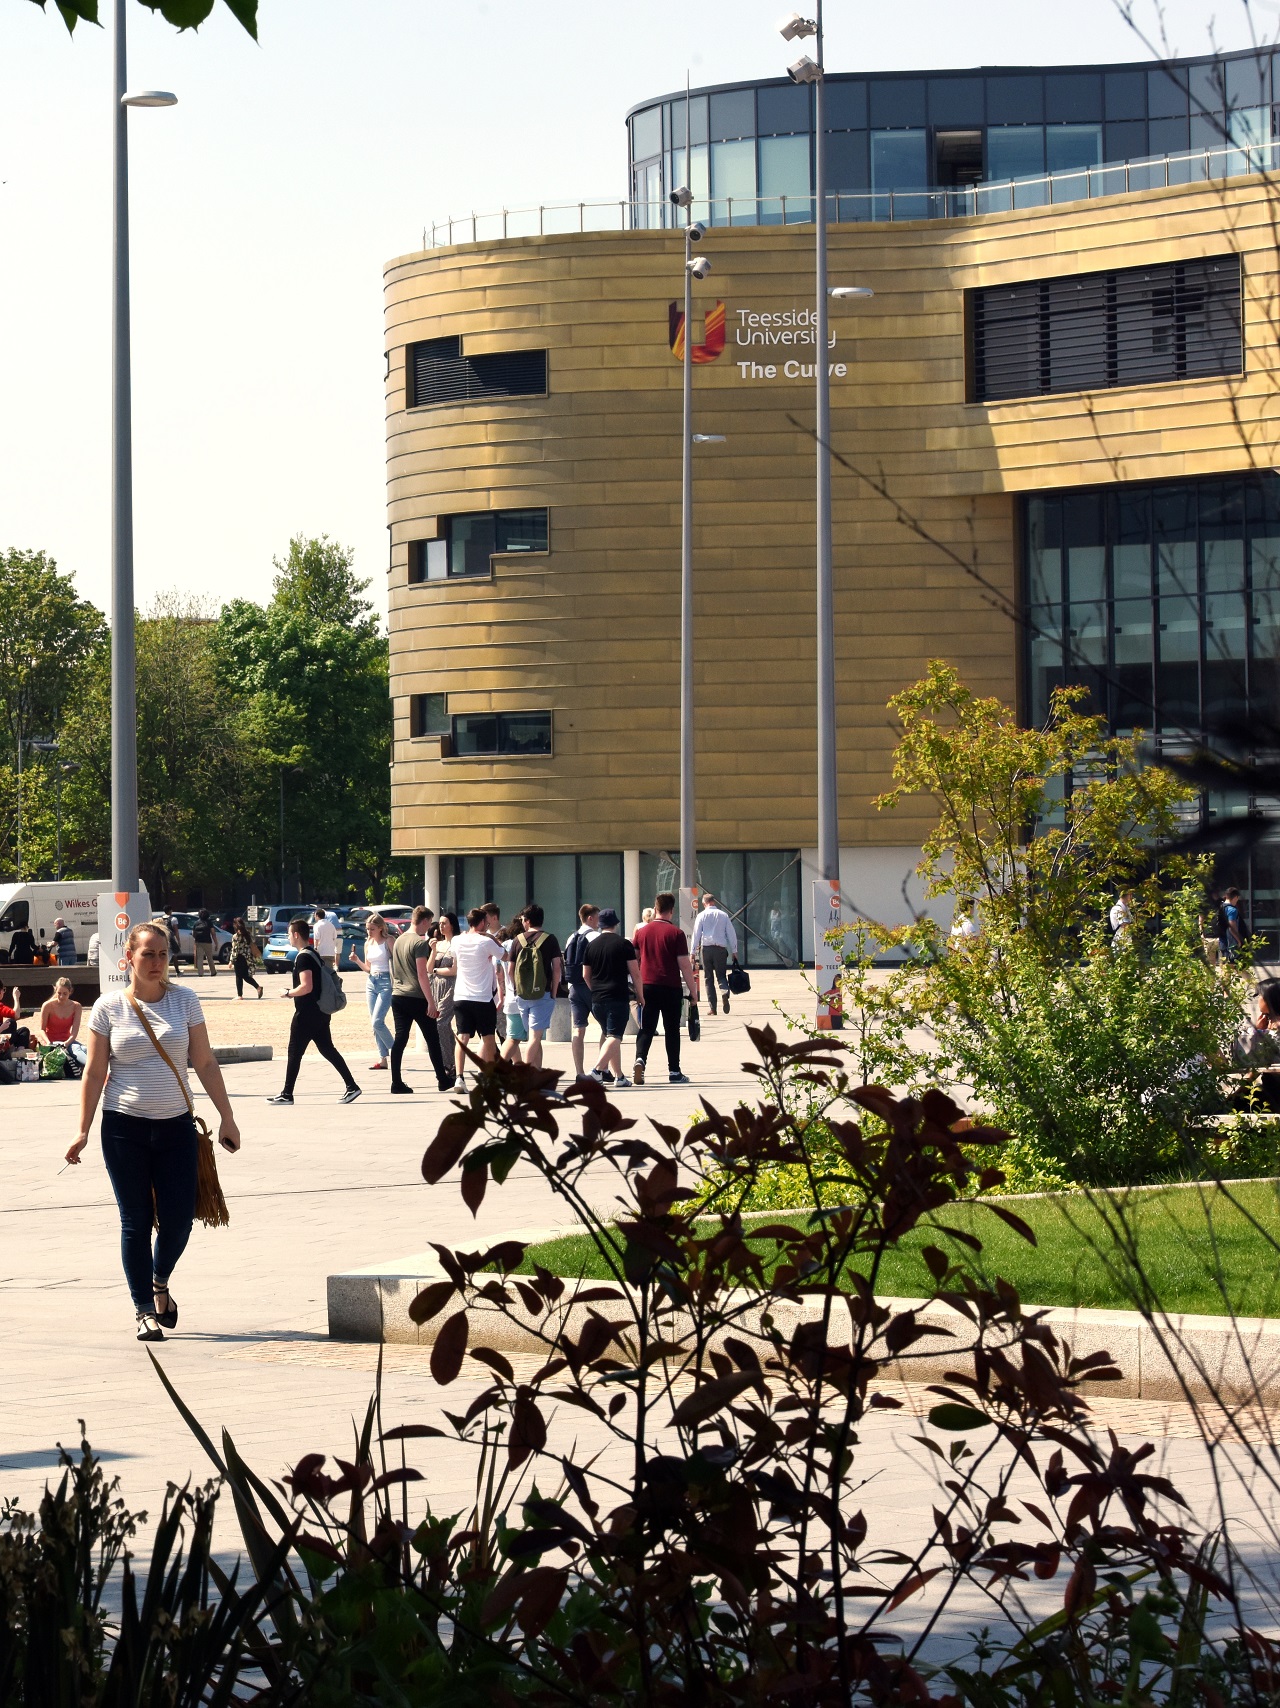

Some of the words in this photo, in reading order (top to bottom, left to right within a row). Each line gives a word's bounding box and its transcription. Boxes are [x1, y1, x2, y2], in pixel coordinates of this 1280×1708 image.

[736, 309, 819, 327] Teesside
[736, 327, 836, 349] Universiy
[736, 361, 777, 379] The
[64, 899, 90, 908] Wilkes
